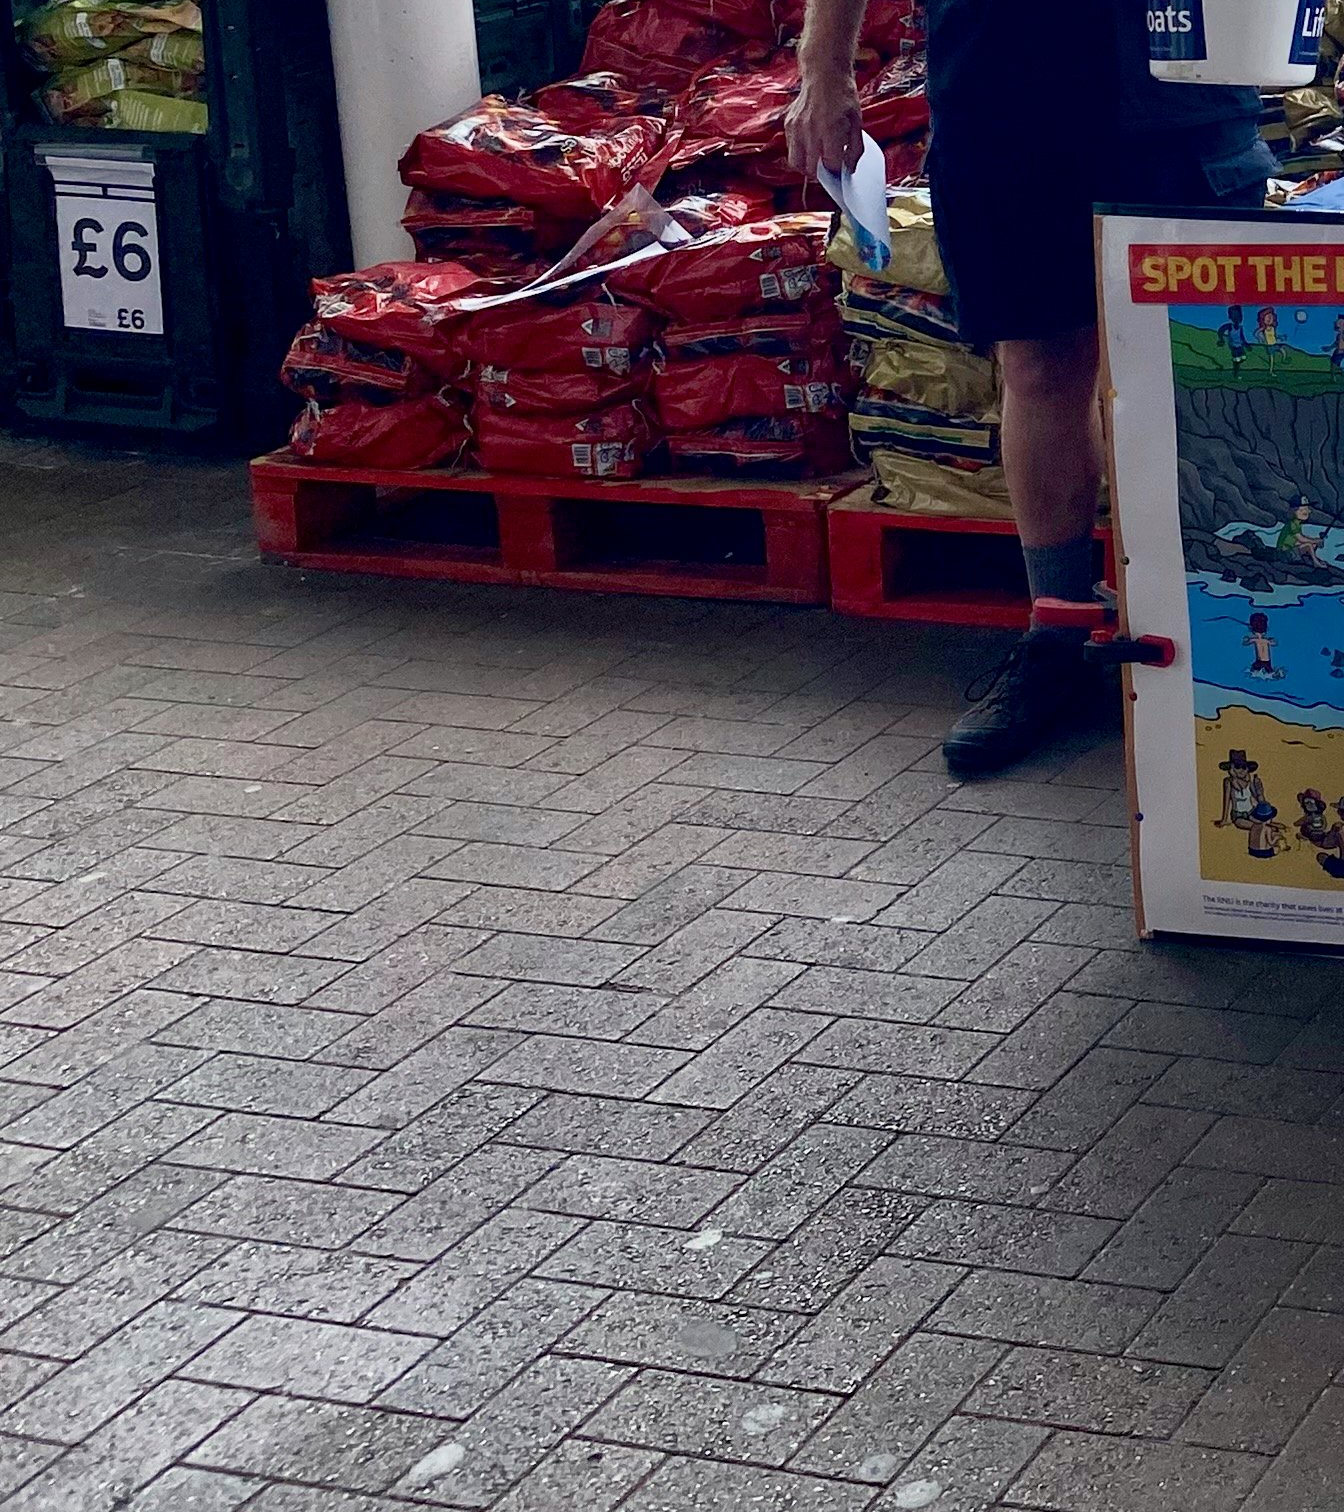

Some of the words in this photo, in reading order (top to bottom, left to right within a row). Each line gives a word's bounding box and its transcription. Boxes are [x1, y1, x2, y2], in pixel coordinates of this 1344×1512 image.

[72, 217, 152, 282] £6
[1140, 255, 1241, 293] SPOT
[1245, 256, 1328, 293] THE
[117, 308, 145, 329] £6
